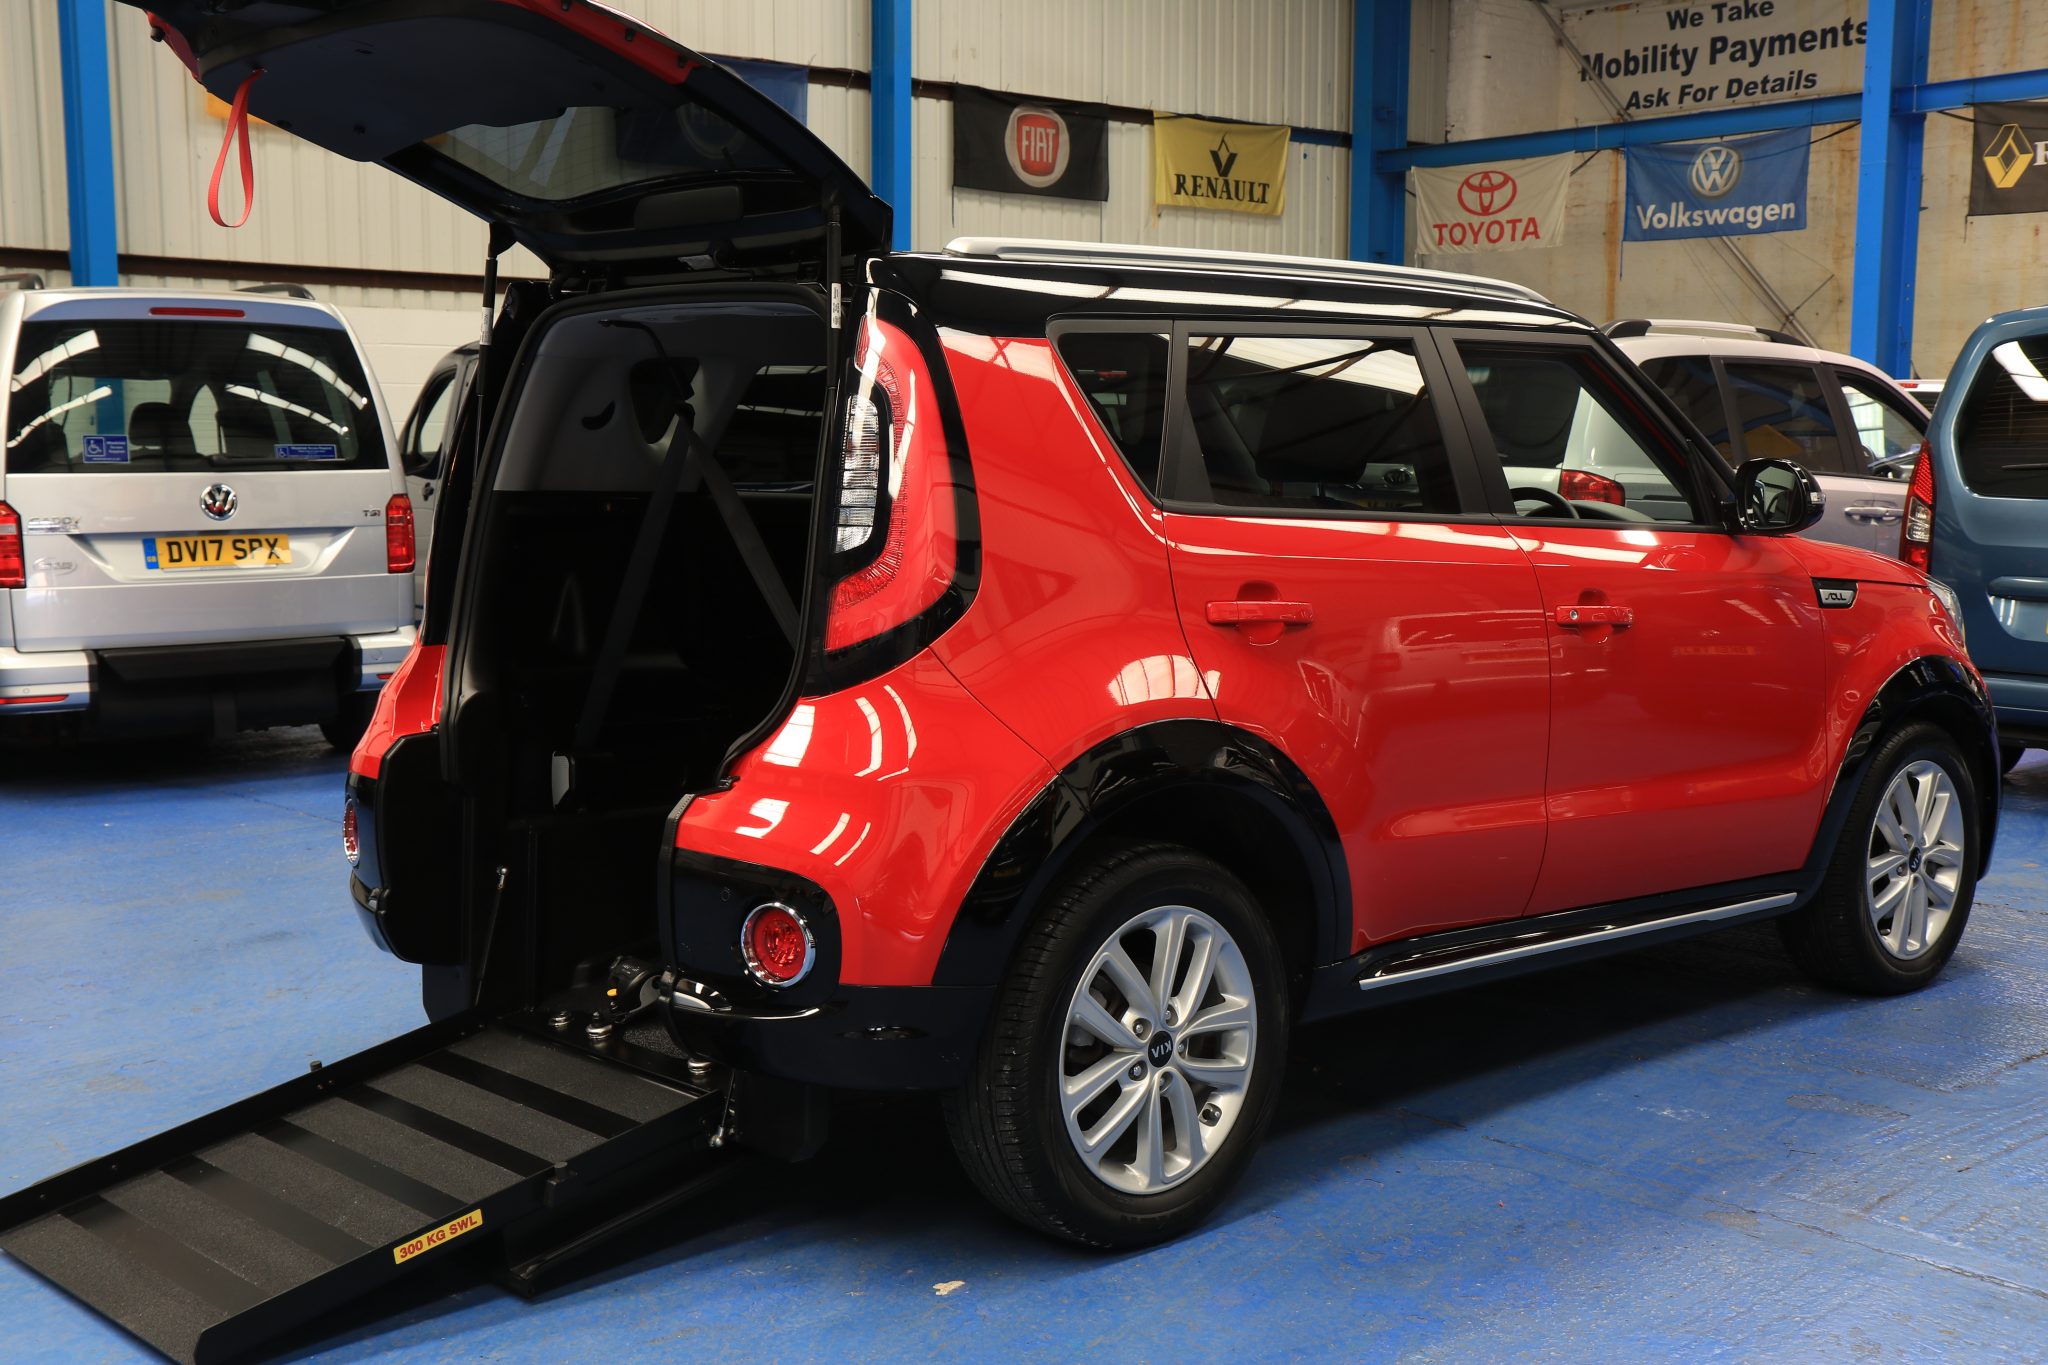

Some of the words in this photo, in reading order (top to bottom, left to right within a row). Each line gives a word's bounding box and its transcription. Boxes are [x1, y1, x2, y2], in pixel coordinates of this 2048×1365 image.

[1666, 9, 1704, 30] We
[1712, 0, 1775, 24] Take
[1580, 44, 1698, 81] Mobility
[1709, 17, 1868, 68] Payments
[1624, 88, 1670, 110] Ask
[1678, 84, 1719, 105] For
[1726, 69, 1818, 99] Details
[1021, 125, 1056, 163] FIAT
[1173, 173, 1270, 204] RENAULT
[1636, 200, 1795, 231] Volkswagen
[1432, 216, 1541, 247] TOYOTA
[166, 540, 224, 563] DV17
[232, 538, 281, 560] SPX
[1151, 1040, 1172, 1058] KIA
[399, 1240, 424, 1259] 300
[426, 1229, 446, 1246] KG
[448, 1216, 478, 1235] SWL
